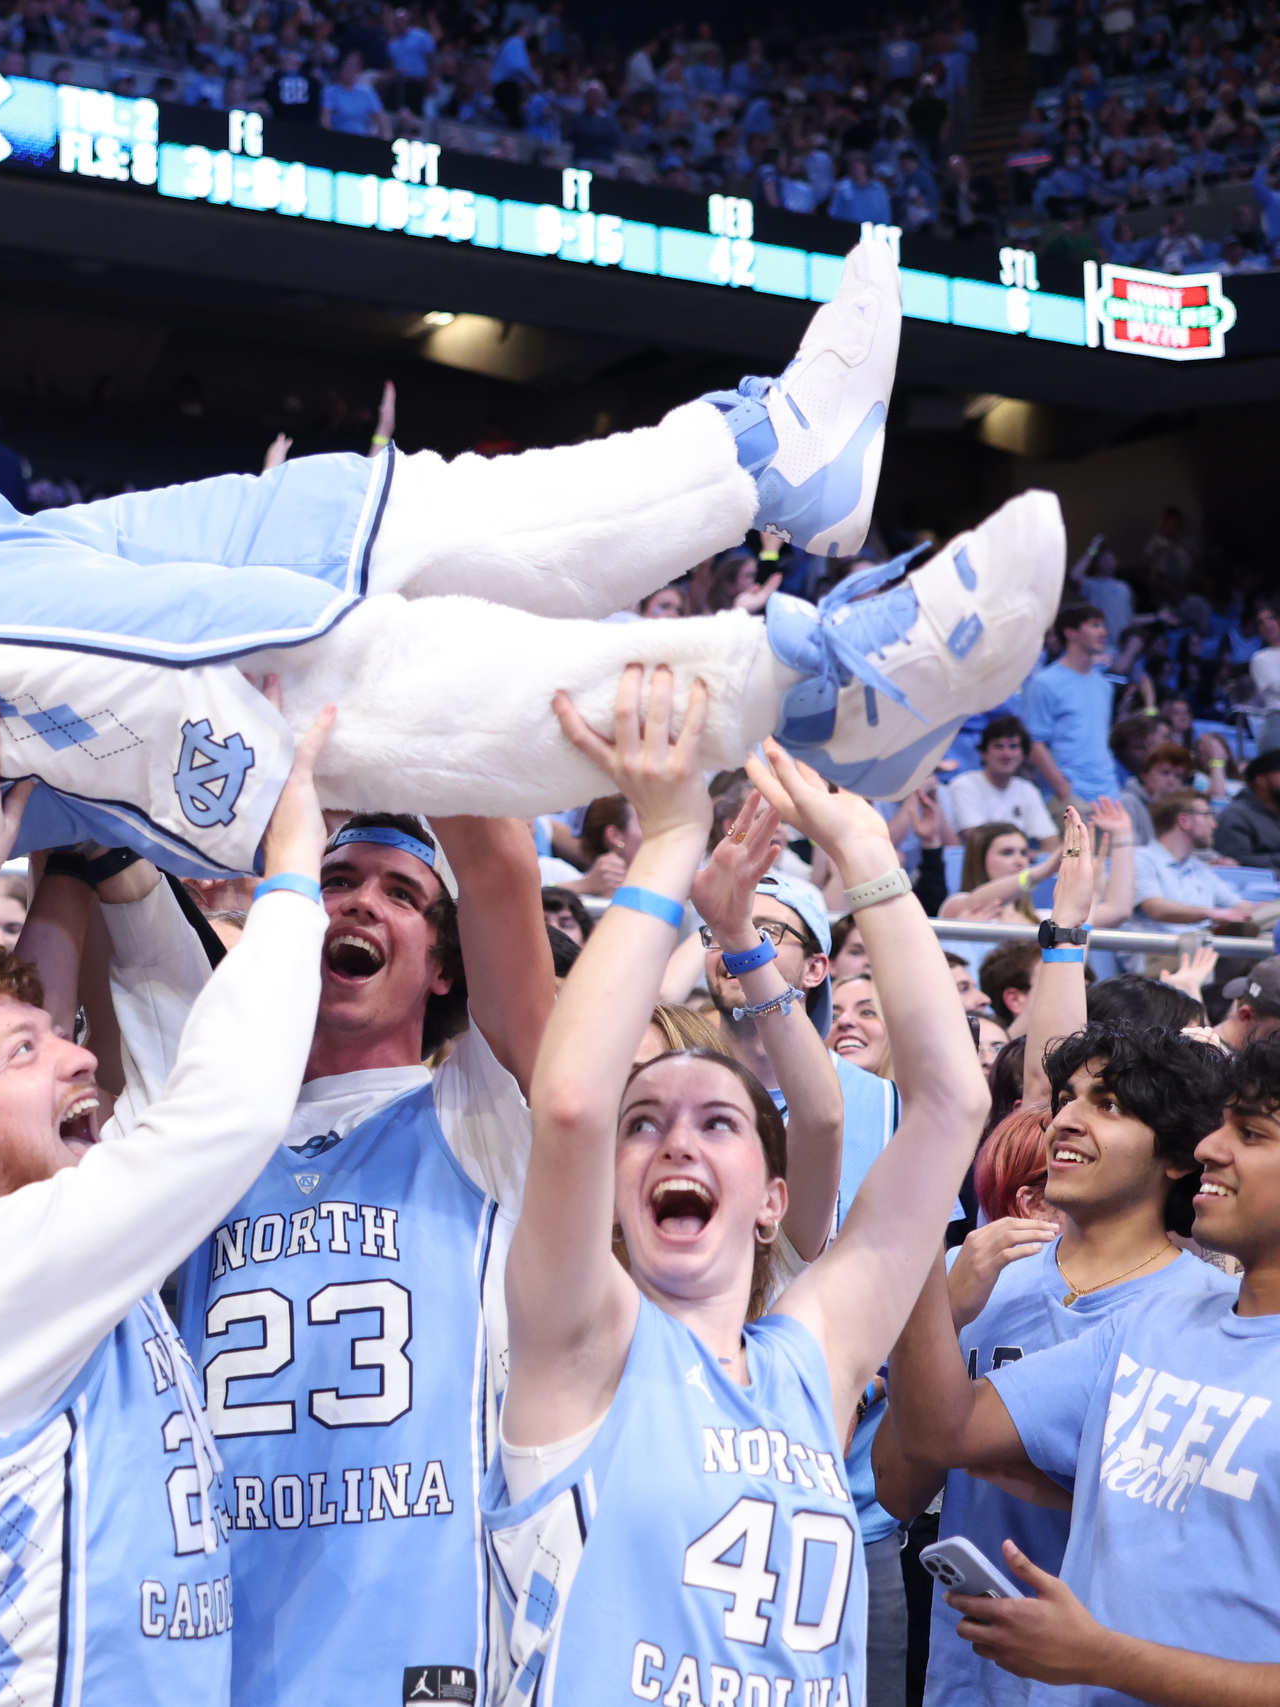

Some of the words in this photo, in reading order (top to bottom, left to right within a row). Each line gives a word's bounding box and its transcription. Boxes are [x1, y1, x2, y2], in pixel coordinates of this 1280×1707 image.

[134, 99, 158, 142] 2
[228, 109, 263, 157] FG
[59, 130, 130, 181] FLS:
[391, 138, 441, 186] 3PT
[562, 168, 592, 212] FT
[709, 238, 755, 287] 42
[999, 246, 1040, 291] STL
[1007, 287, 1030, 333] 6
[213, 1201, 400, 1281] NORTH
[204, 1279, 413, 1439] 23
[161, 1409, 229, 1557] 2
[703, 1425, 850, 1503] NORTH
[223, 1460, 454, 1531] ROLINA
[683, 1495, 855, 1654] 40
[451, 1669, 465, 1686] M
